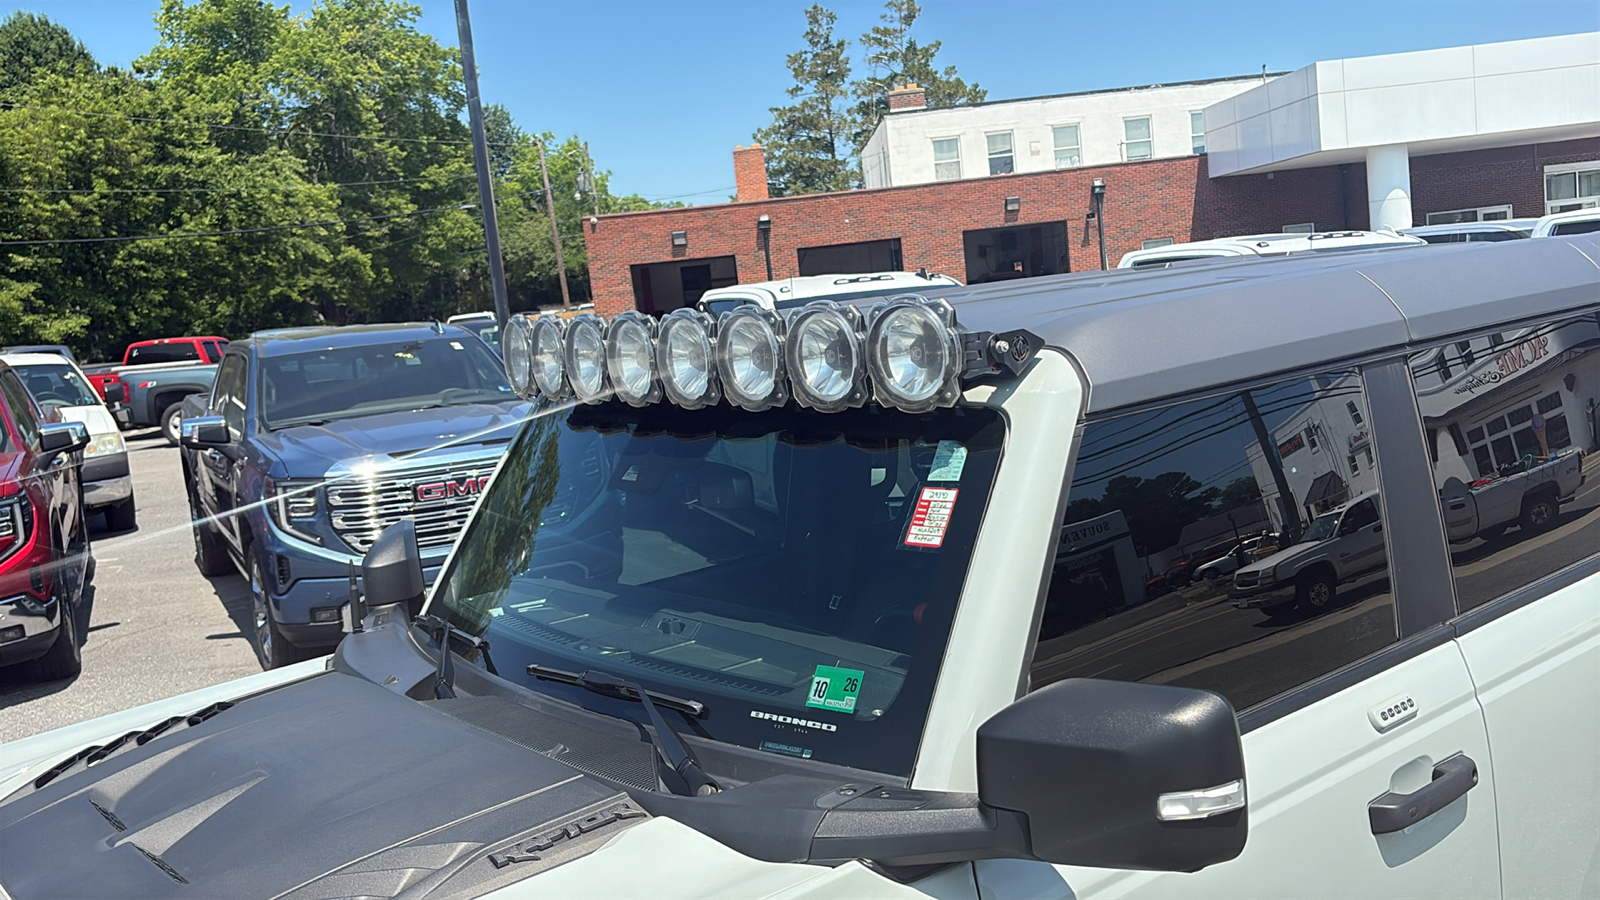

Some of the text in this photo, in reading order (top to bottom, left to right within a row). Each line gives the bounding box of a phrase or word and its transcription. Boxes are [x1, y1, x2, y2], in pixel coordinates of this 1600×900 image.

[813, 677, 858, 698] 10 26
[750, 710, 837, 732] BRONCO
